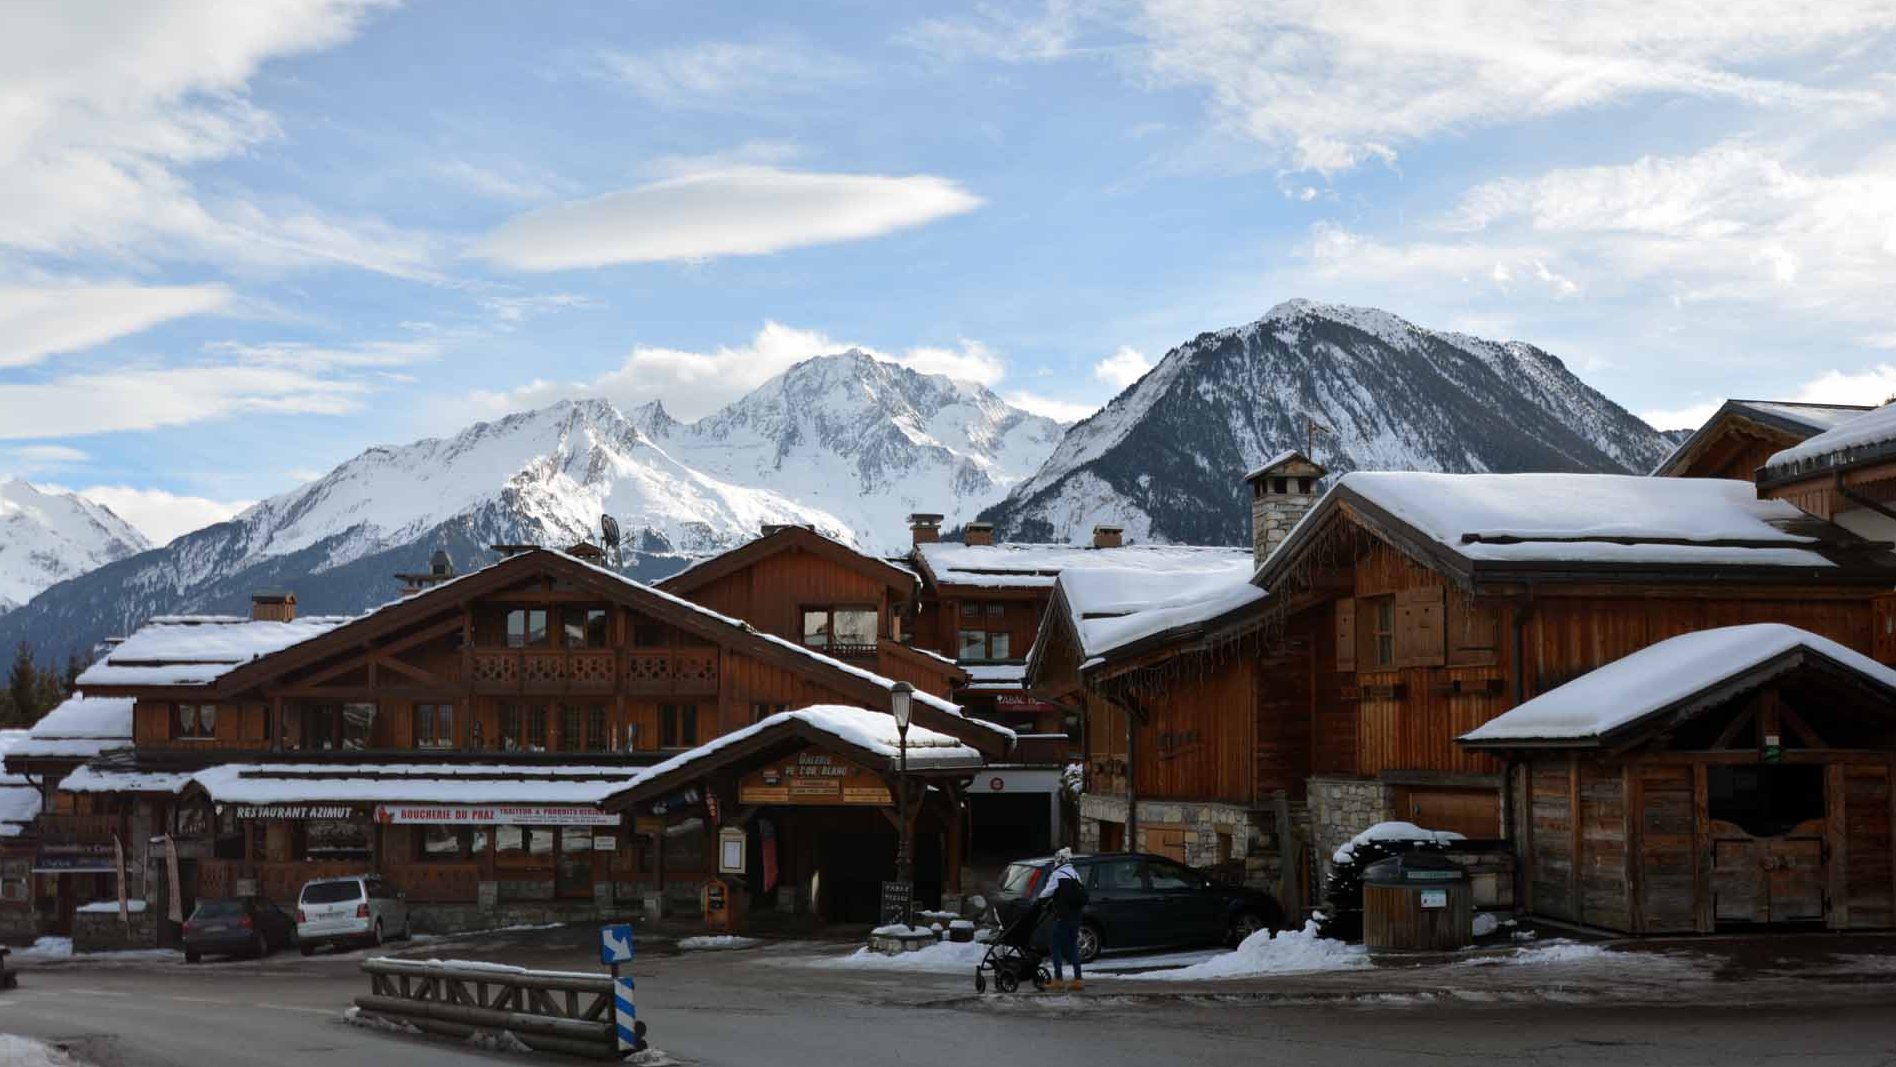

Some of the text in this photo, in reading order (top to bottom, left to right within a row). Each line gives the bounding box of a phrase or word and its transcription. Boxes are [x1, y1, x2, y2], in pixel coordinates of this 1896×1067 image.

[236, 806, 353, 818] RESTAURANT AZIMUT
[401, 808, 495, 820] BOUCHERIE DU PRAZ
